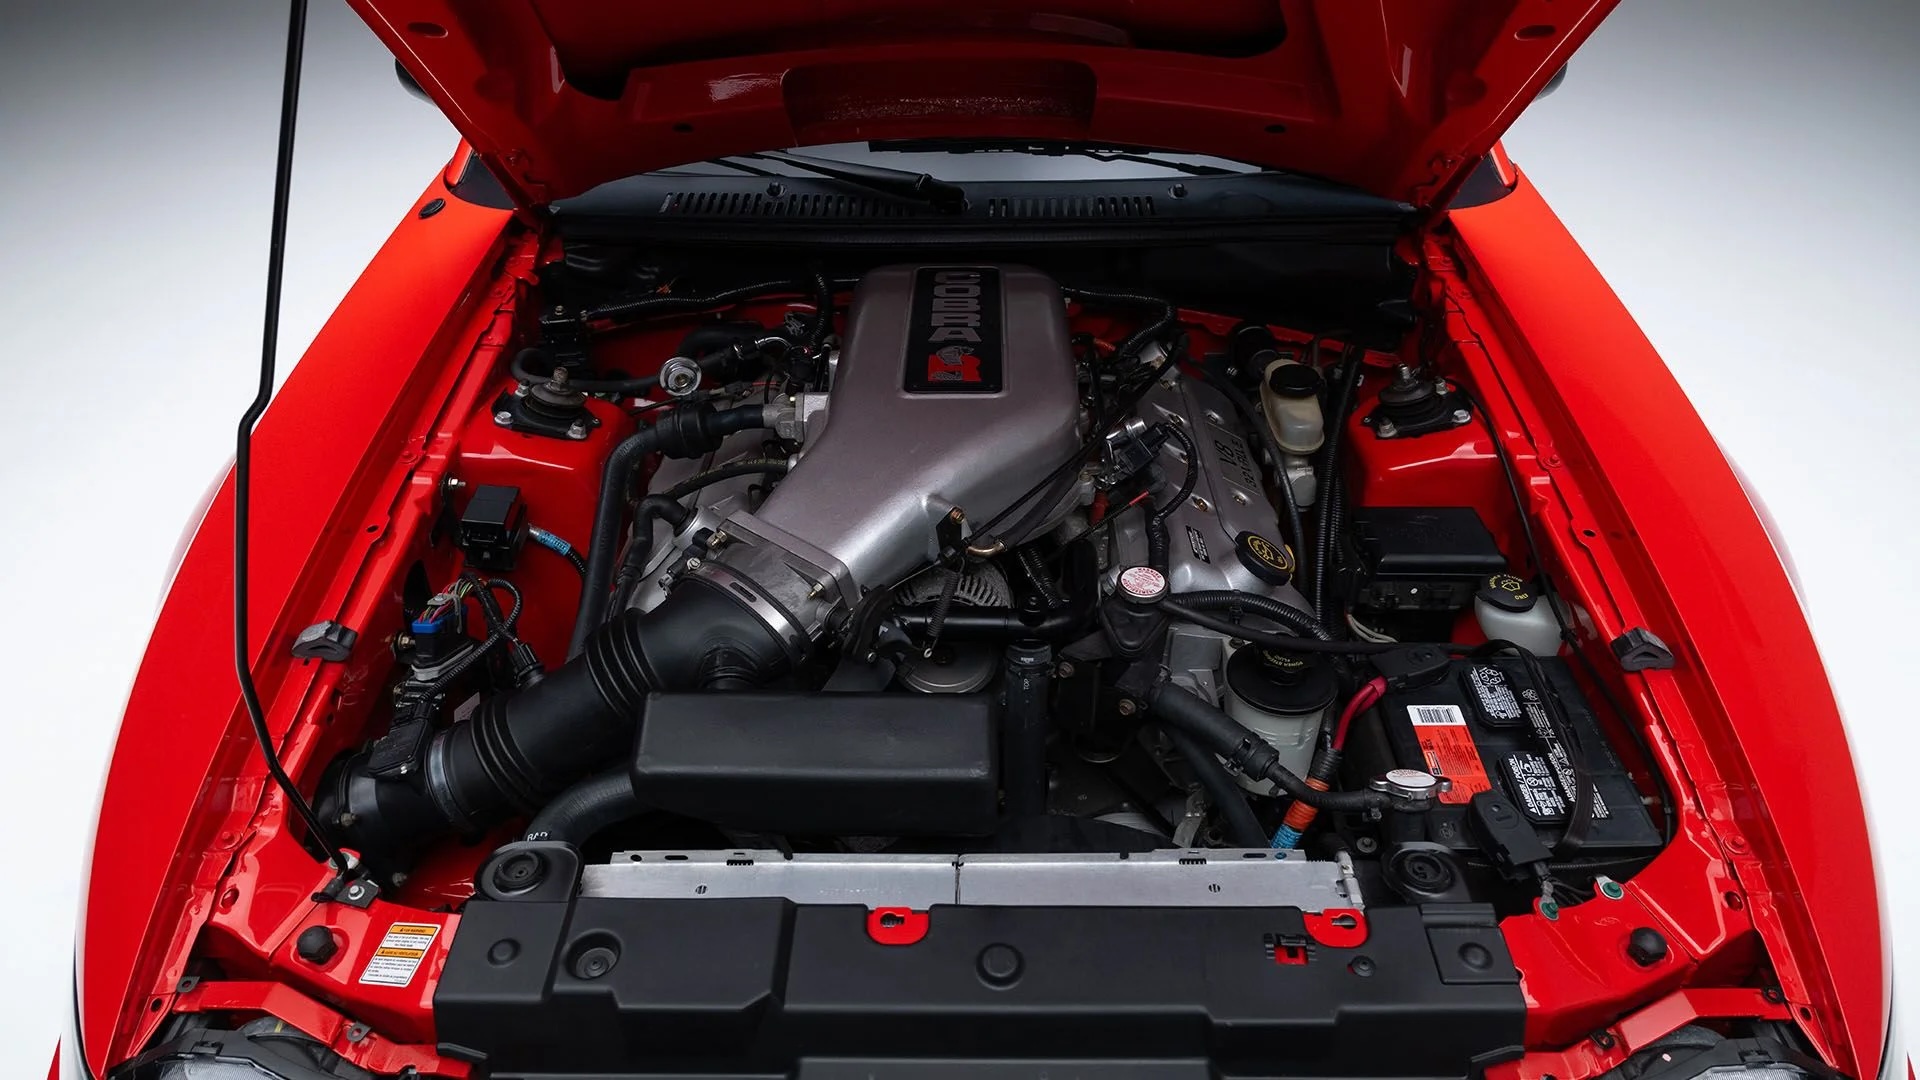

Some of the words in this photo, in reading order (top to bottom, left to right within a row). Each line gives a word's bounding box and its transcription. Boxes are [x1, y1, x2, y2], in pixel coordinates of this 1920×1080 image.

[928, 272, 982, 342] COBRA
[1214, 439, 1237, 466] V8
[1508, 758, 1522, 779] POISON
[1519, 783, 1535, 808] DANGER
